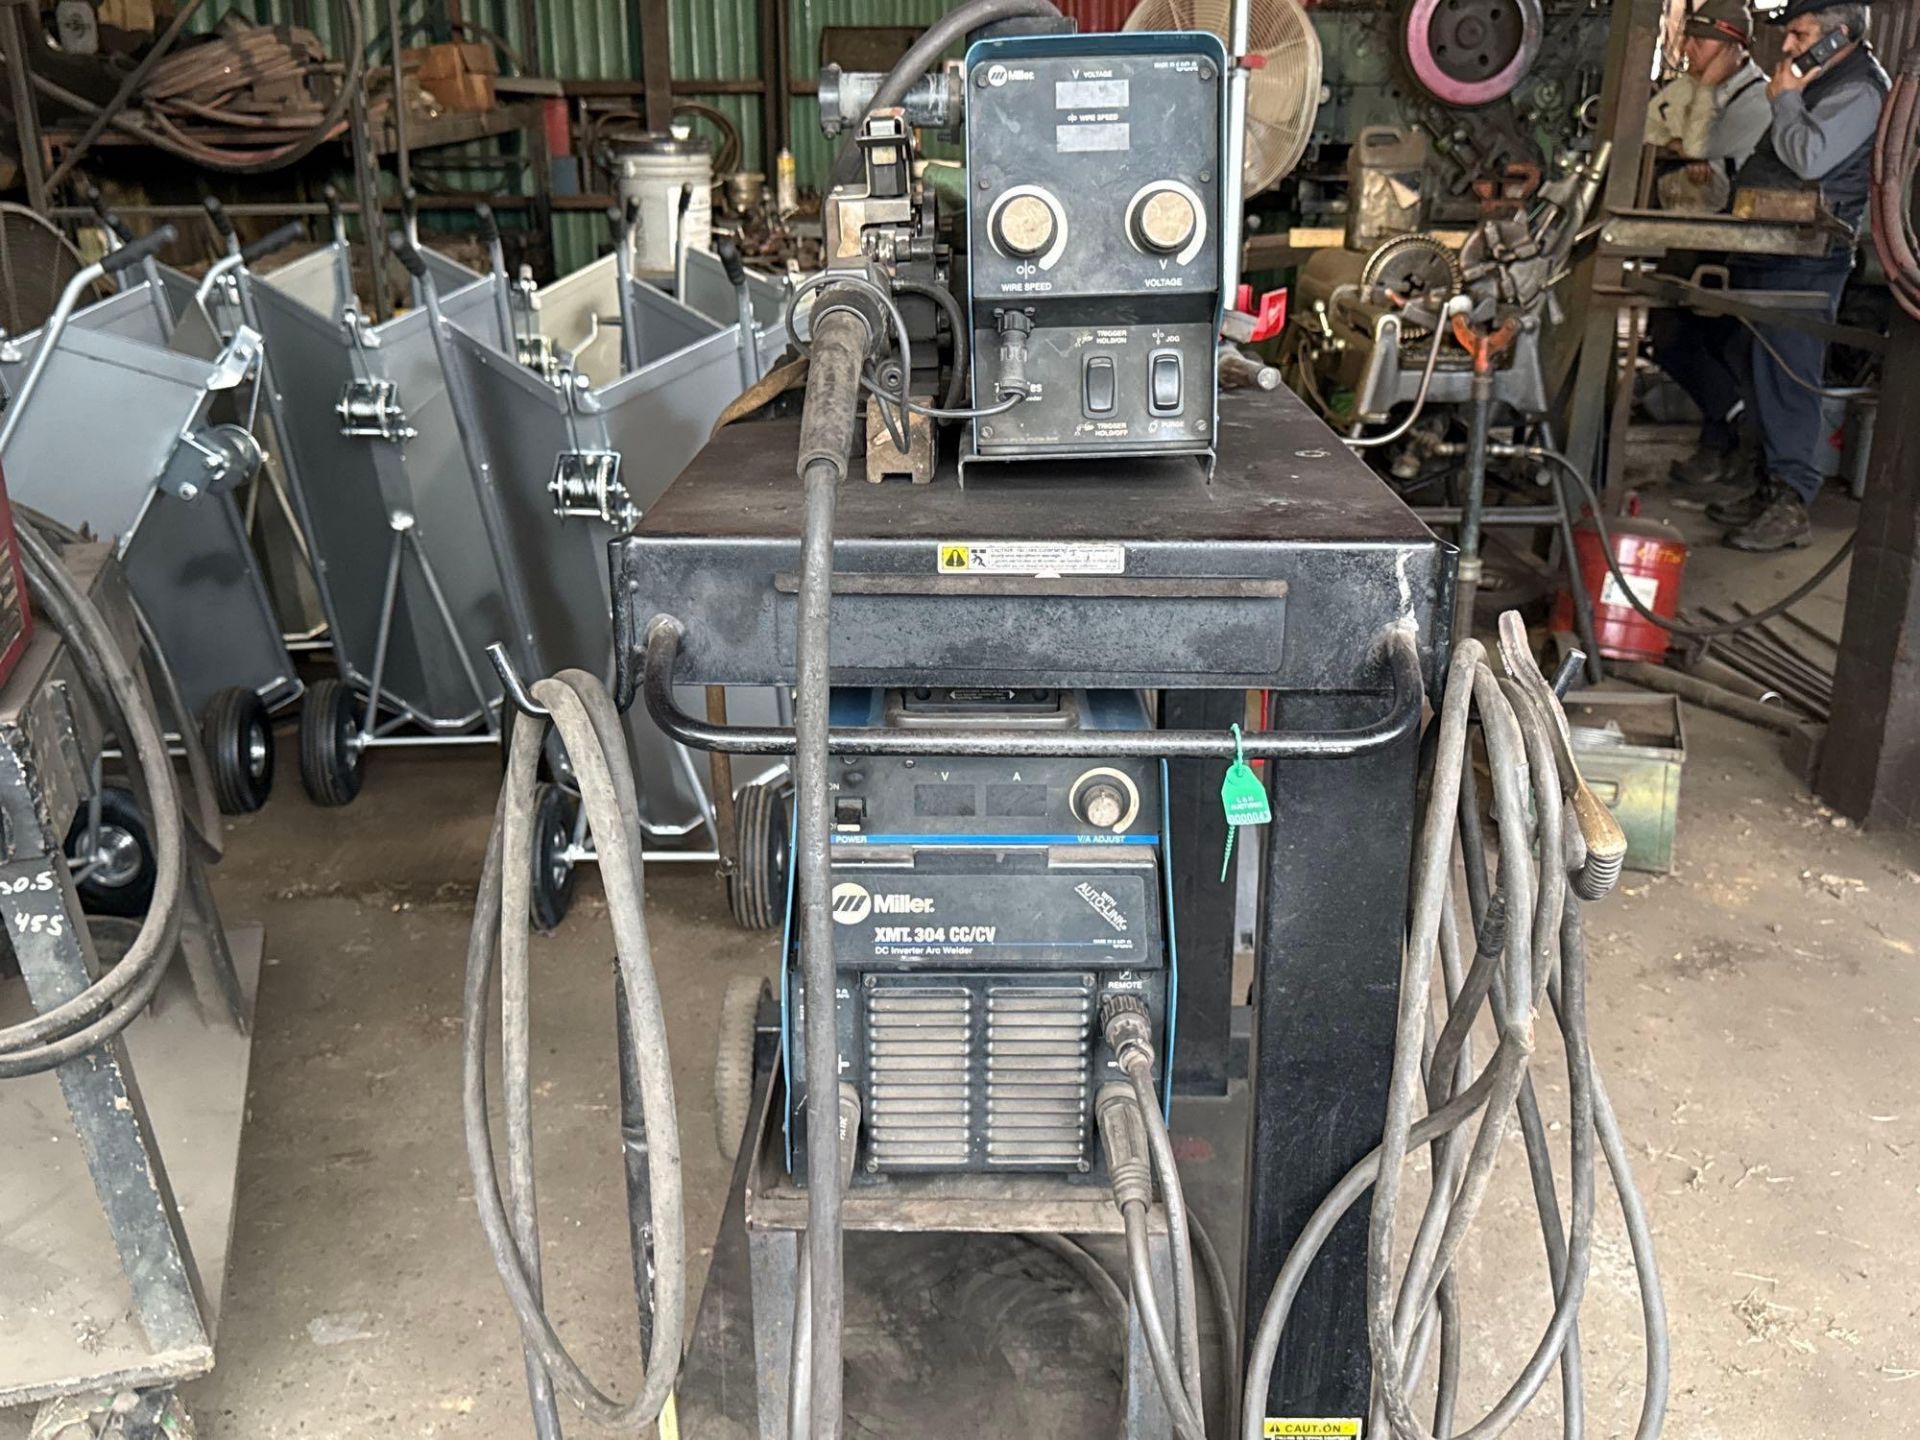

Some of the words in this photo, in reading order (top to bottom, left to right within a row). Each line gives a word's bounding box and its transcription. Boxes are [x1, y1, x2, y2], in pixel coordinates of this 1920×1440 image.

[1083, 70, 1113, 78] VOLTAGE
[1158, 258, 1168, 271] V
[1001, 283, 1023, 292] WIRE
[1024, 282, 1052, 292] SPEED
[1144, 277, 1183, 288] VOLTAGE
[1096, 329, 1128, 337] TRIGGER
[1165, 335, 1180, 343] JOG
[1096, 422, 1128, 430] TRIGGER
[941, 771, 950, 781] V
[1012, 771, 1022, 782] A
[835, 835, 868, 844] POWER
[1092, 834, 1126, 844] ADJUST
[914, 926, 946, 943] 304
[949, 926, 997, 943] CC/CV
[875, 946, 890, 955] DC
[891, 946, 924, 955] Inverter
[925, 946, 941, 955] Arc
[942, 946, 974, 955] Welder
[1107, 981, 1143, 990] REMOTE
